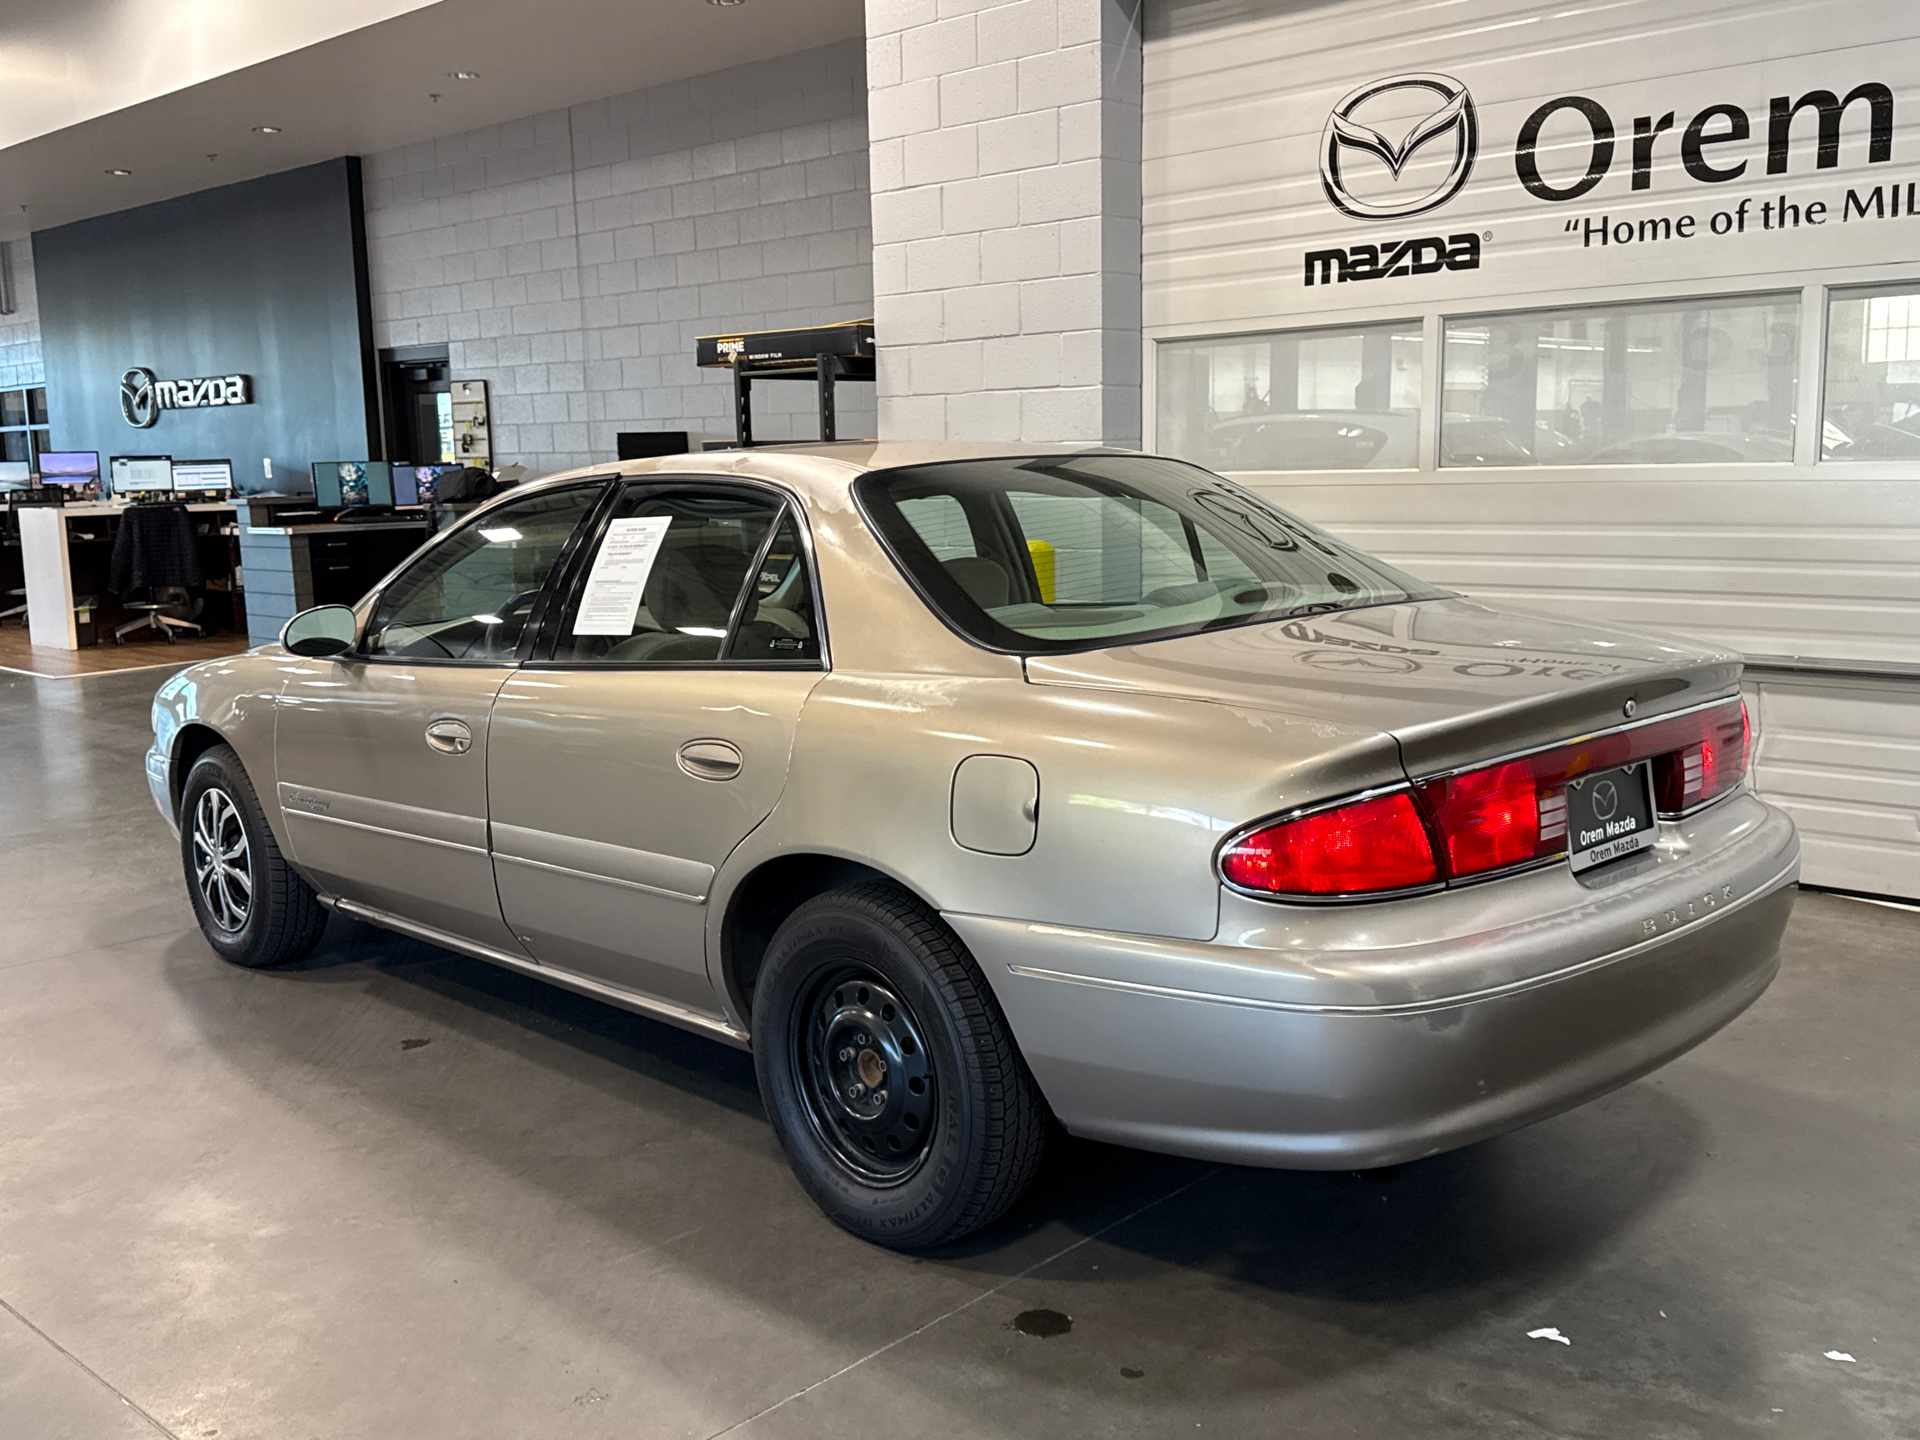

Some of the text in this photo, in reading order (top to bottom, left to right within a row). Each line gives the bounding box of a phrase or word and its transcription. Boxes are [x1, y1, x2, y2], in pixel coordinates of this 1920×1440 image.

[1515, 82, 1894, 202] Orem
[1710, 198, 1753, 236] of
[1761, 193, 1828, 229] the
[1304, 232, 1481, 287] mazda
[716, 341, 745, 354] PRIME
[154, 375, 248, 409] mazda
[1580, 815, 1636, 846] Orem Mazda
[1590, 837, 1639, 863] Orem Mazda
[1640, 883, 1733, 934] BUICK
